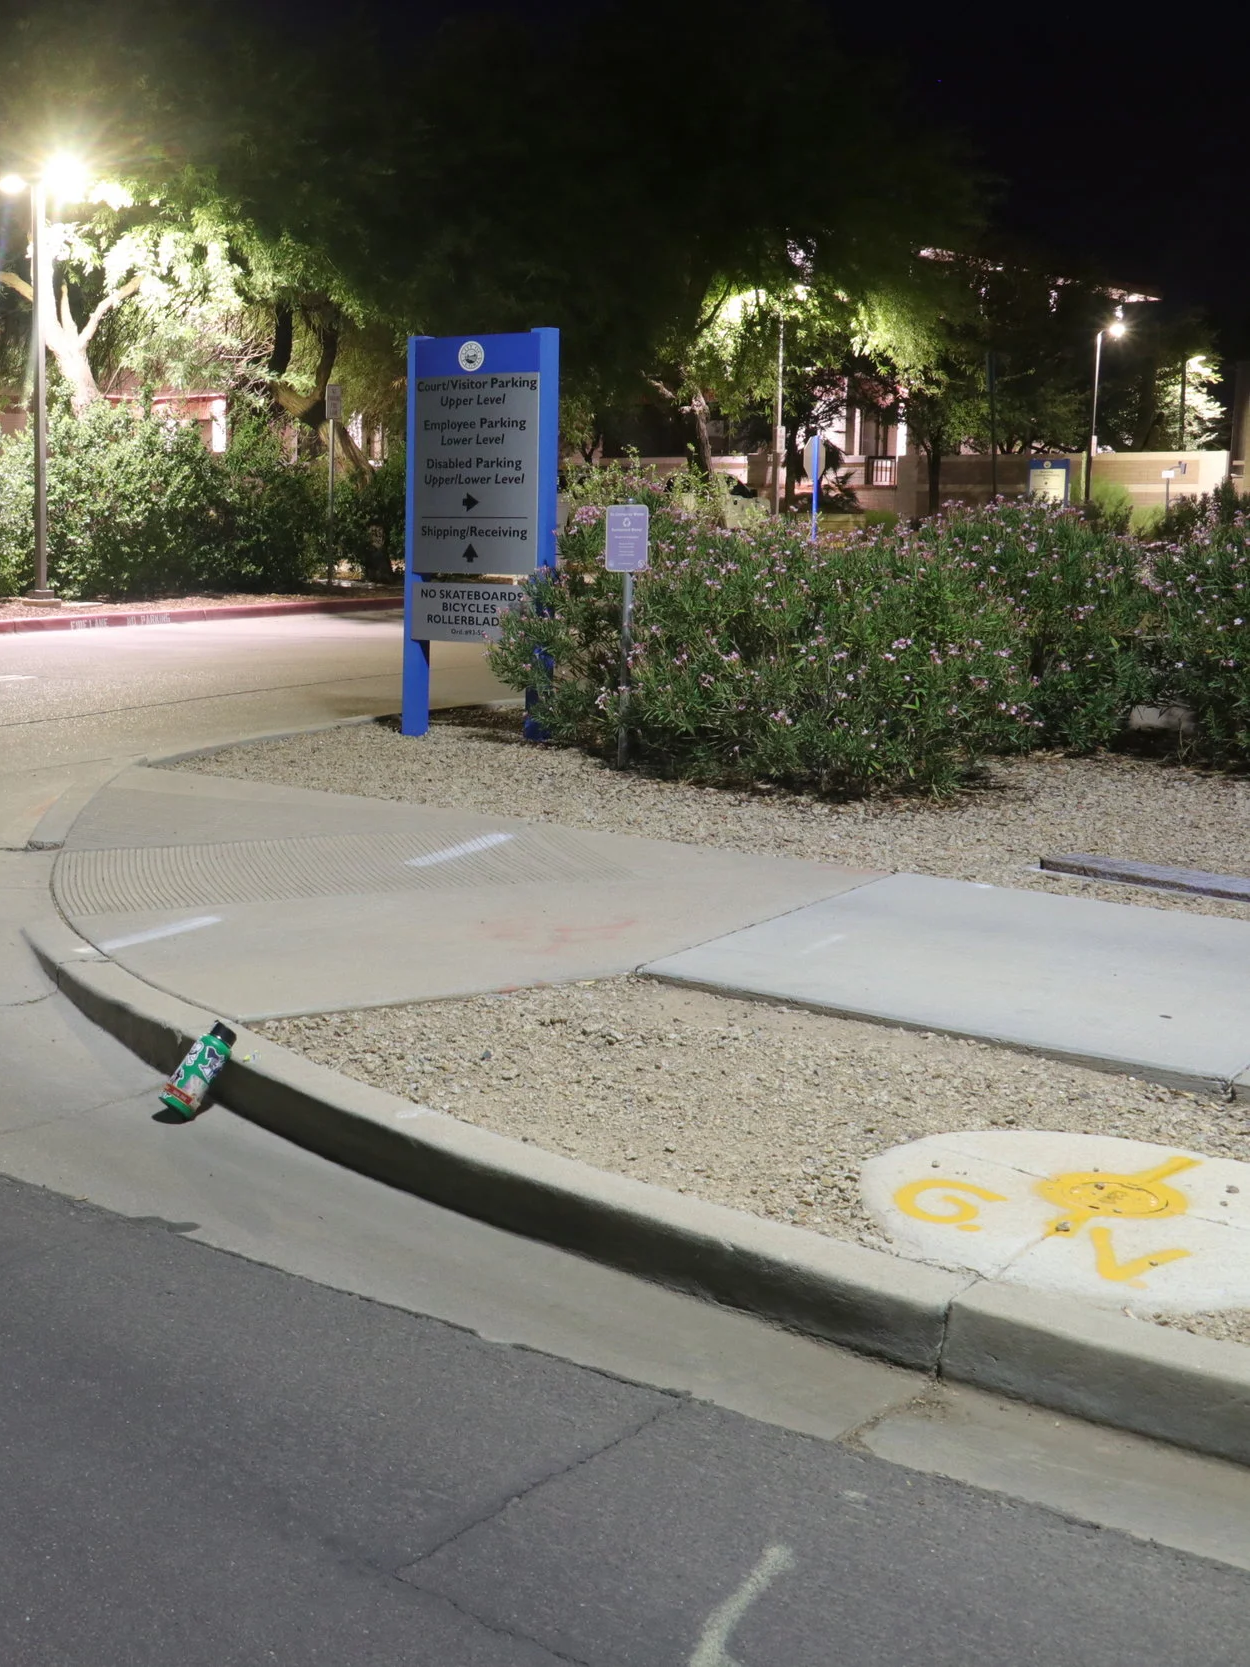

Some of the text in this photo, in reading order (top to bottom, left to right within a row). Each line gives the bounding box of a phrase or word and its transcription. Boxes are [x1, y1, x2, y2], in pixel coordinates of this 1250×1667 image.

[417, 377, 537, 392] Court/Visitor Parking
[441, 393, 506, 409] Upper Level
[424, 417, 526, 432] Employee Parking
[441, 434, 505, 446] Lower Level
[427, 458, 522, 471] Disabled Parking
[424, 473, 524, 487] Upper/Lower Level
[421, 526, 527, 540] Shipping/Receiving
[421, 589, 524, 602] NO SKATEBOARDS
[442, 603, 496, 614] BICYCLES
[141, 614, 170, 626] PARKING
[427, 614, 499, 626] ROLLERBLAD
